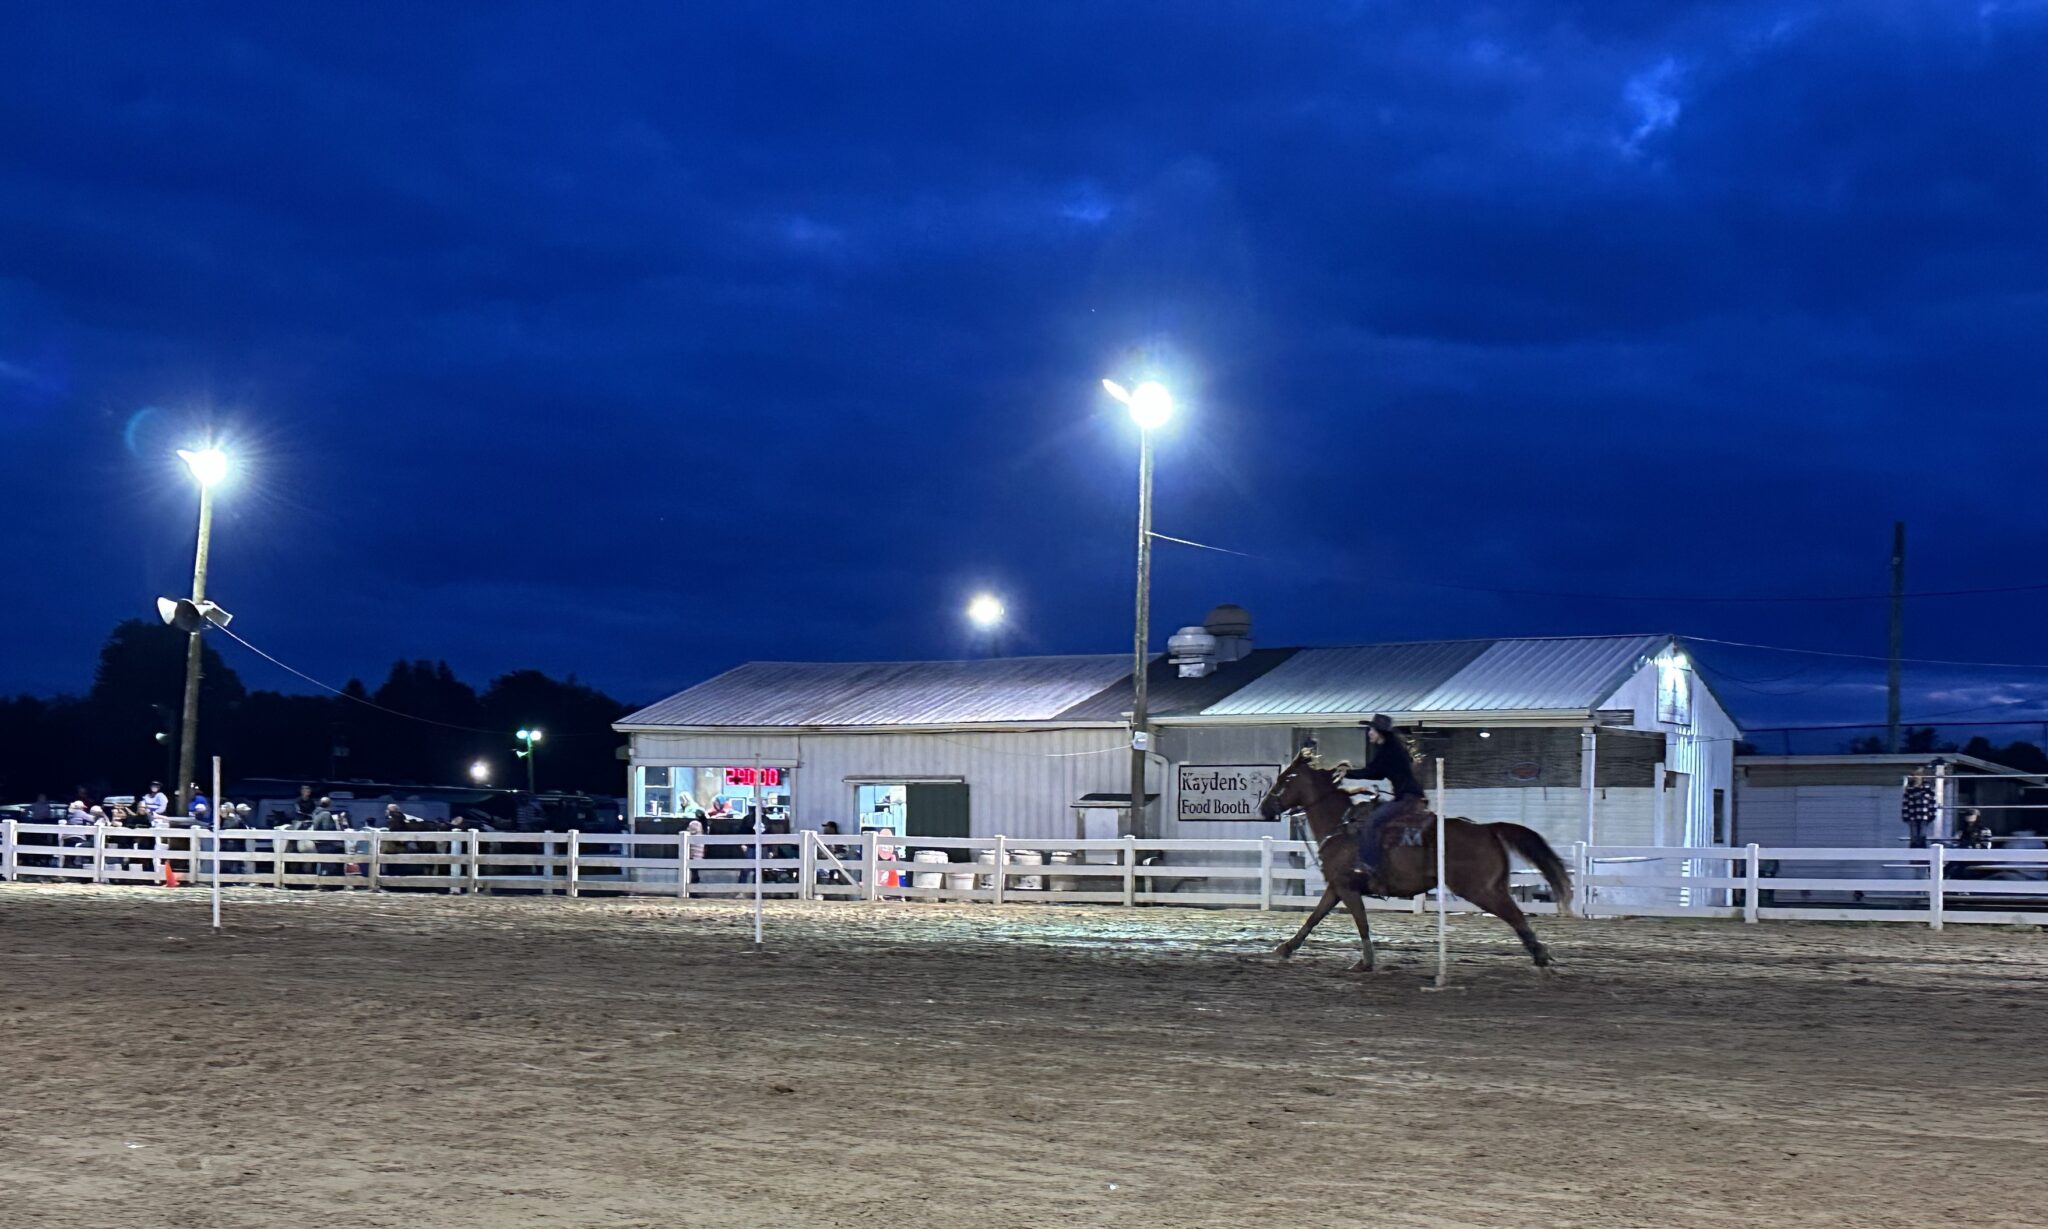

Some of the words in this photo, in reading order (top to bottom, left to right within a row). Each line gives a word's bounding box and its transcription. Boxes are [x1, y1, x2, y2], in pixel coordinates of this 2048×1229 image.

[1182, 772, 1247, 794] Kayden's
[1182, 799, 1210, 814] Food
[1214, 798, 1250, 814] Booth
